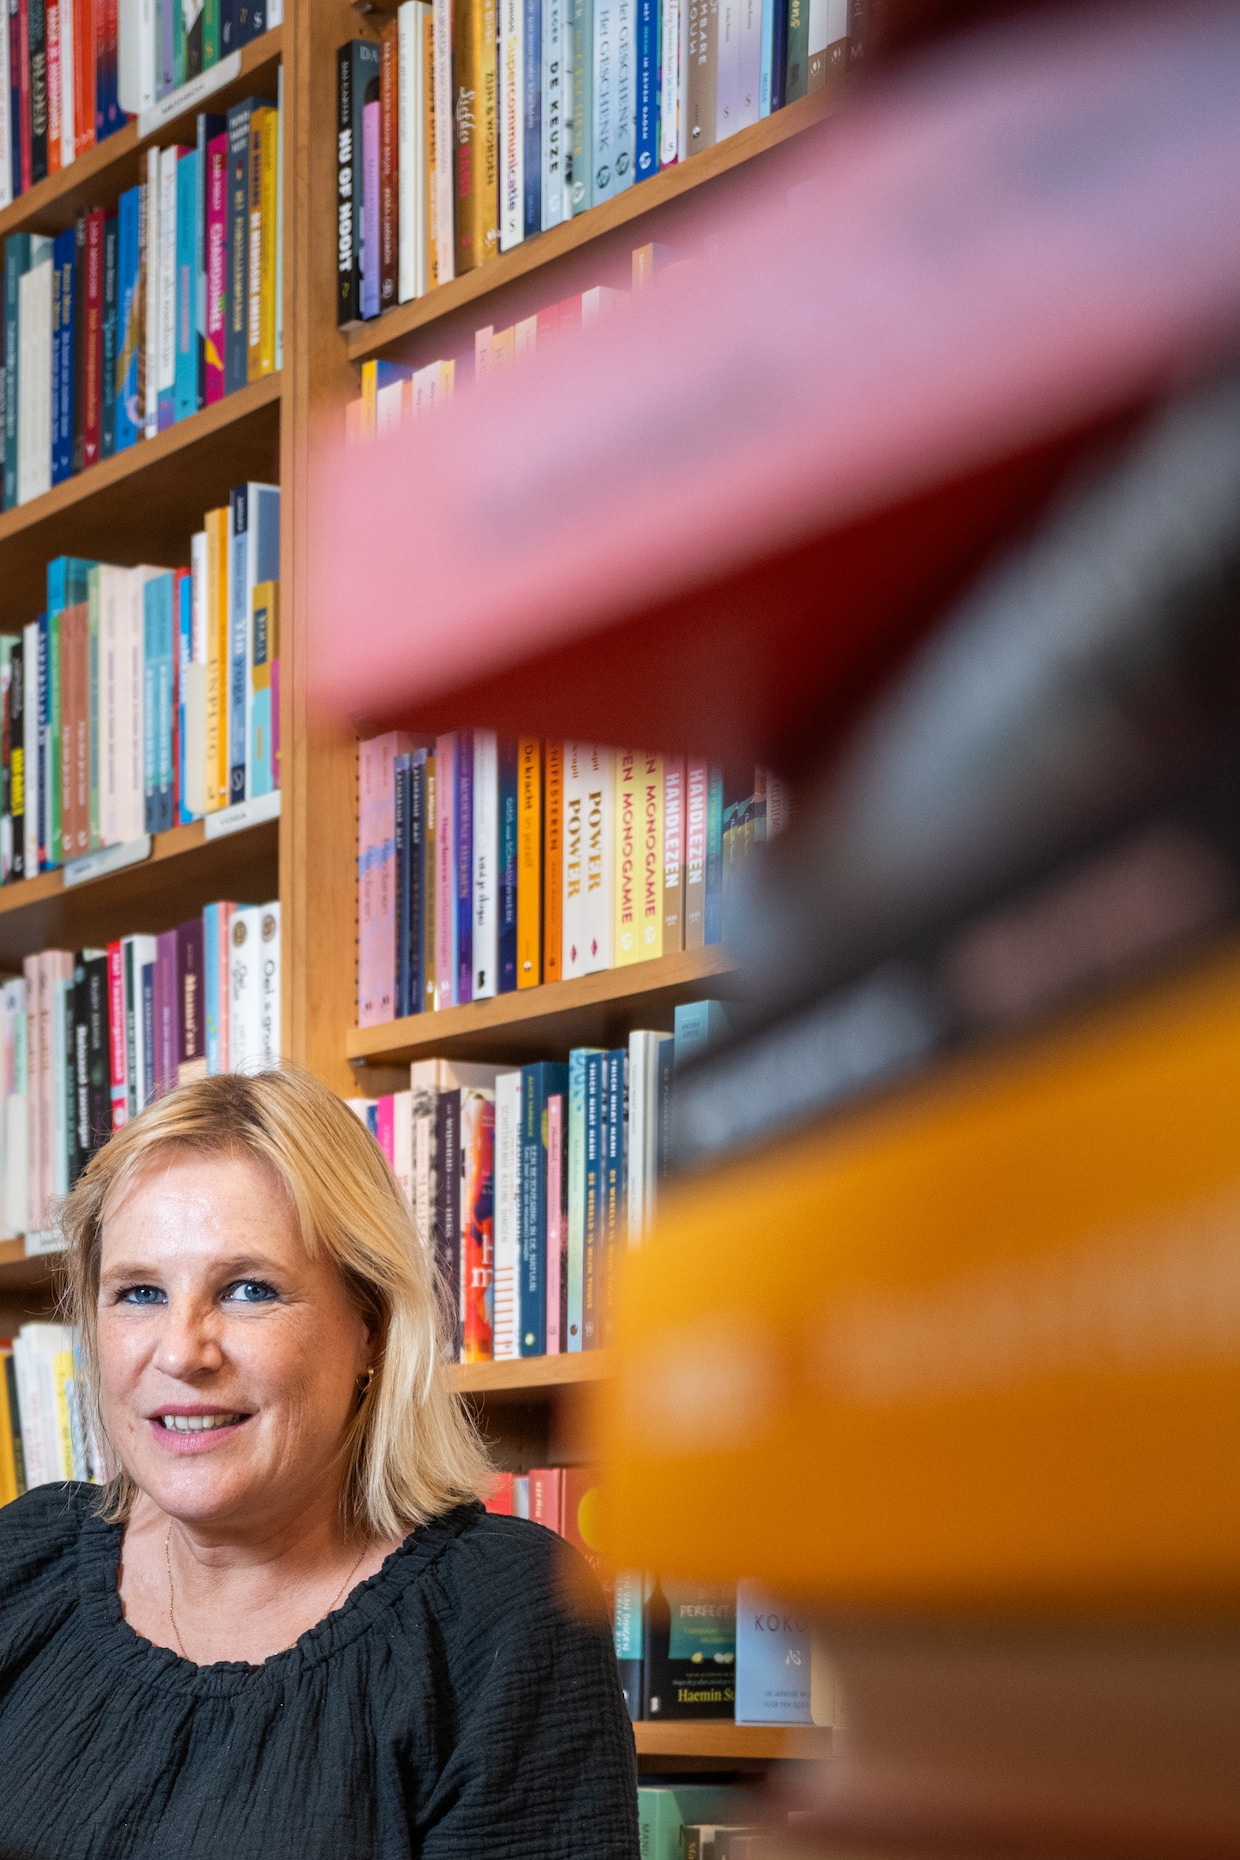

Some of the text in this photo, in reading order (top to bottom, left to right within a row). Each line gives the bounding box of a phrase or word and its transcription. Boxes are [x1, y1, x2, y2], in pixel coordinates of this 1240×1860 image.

[597, 9, 611, 153] Het GESCHENK
[617, 26, 631, 139] GESCHENK
[643, 57, 649, 68] IN
[485, 71, 495, 185] ZIJN WORDEN
[503, 36, 518, 212] Supercommunicatie
[549, 61, 559, 174] DE KEUZE
[338, 128, 353, 273] NU OF NOOIT
[458, 146, 472, 199] BANG
[206, 658, 219, 762] UNPLUG
[524, 744, 534, 810] De kracht
[688, 769, 703, 885] HANDLEZEN
[567, 798, 581, 899] POWER
[588, 790, 602, 893] POWER
[622, 793, 633, 925] MONOGAMIE
[644, 785, 656, 918] MONOGAMIE
[665, 773, 680, 888] HANDLEZEN
[505, 842, 513, 924] SCHADUWWERK
[76, 1025, 89, 1148] Relaxed zwanger
[588, 1061, 596, 1160] THICH NHAT HANH
[609, 1095, 617, 1124] NHAT
[609, 1126, 617, 1158] HANH
[586, 1172, 595, 1309] DE WERELD IS MIJN THUIS
[608, 1169, 616, 1228] DE WERELD
[622, 1613, 630, 1651] DINGEN
[678, 1688, 722, 1702] Haemin
